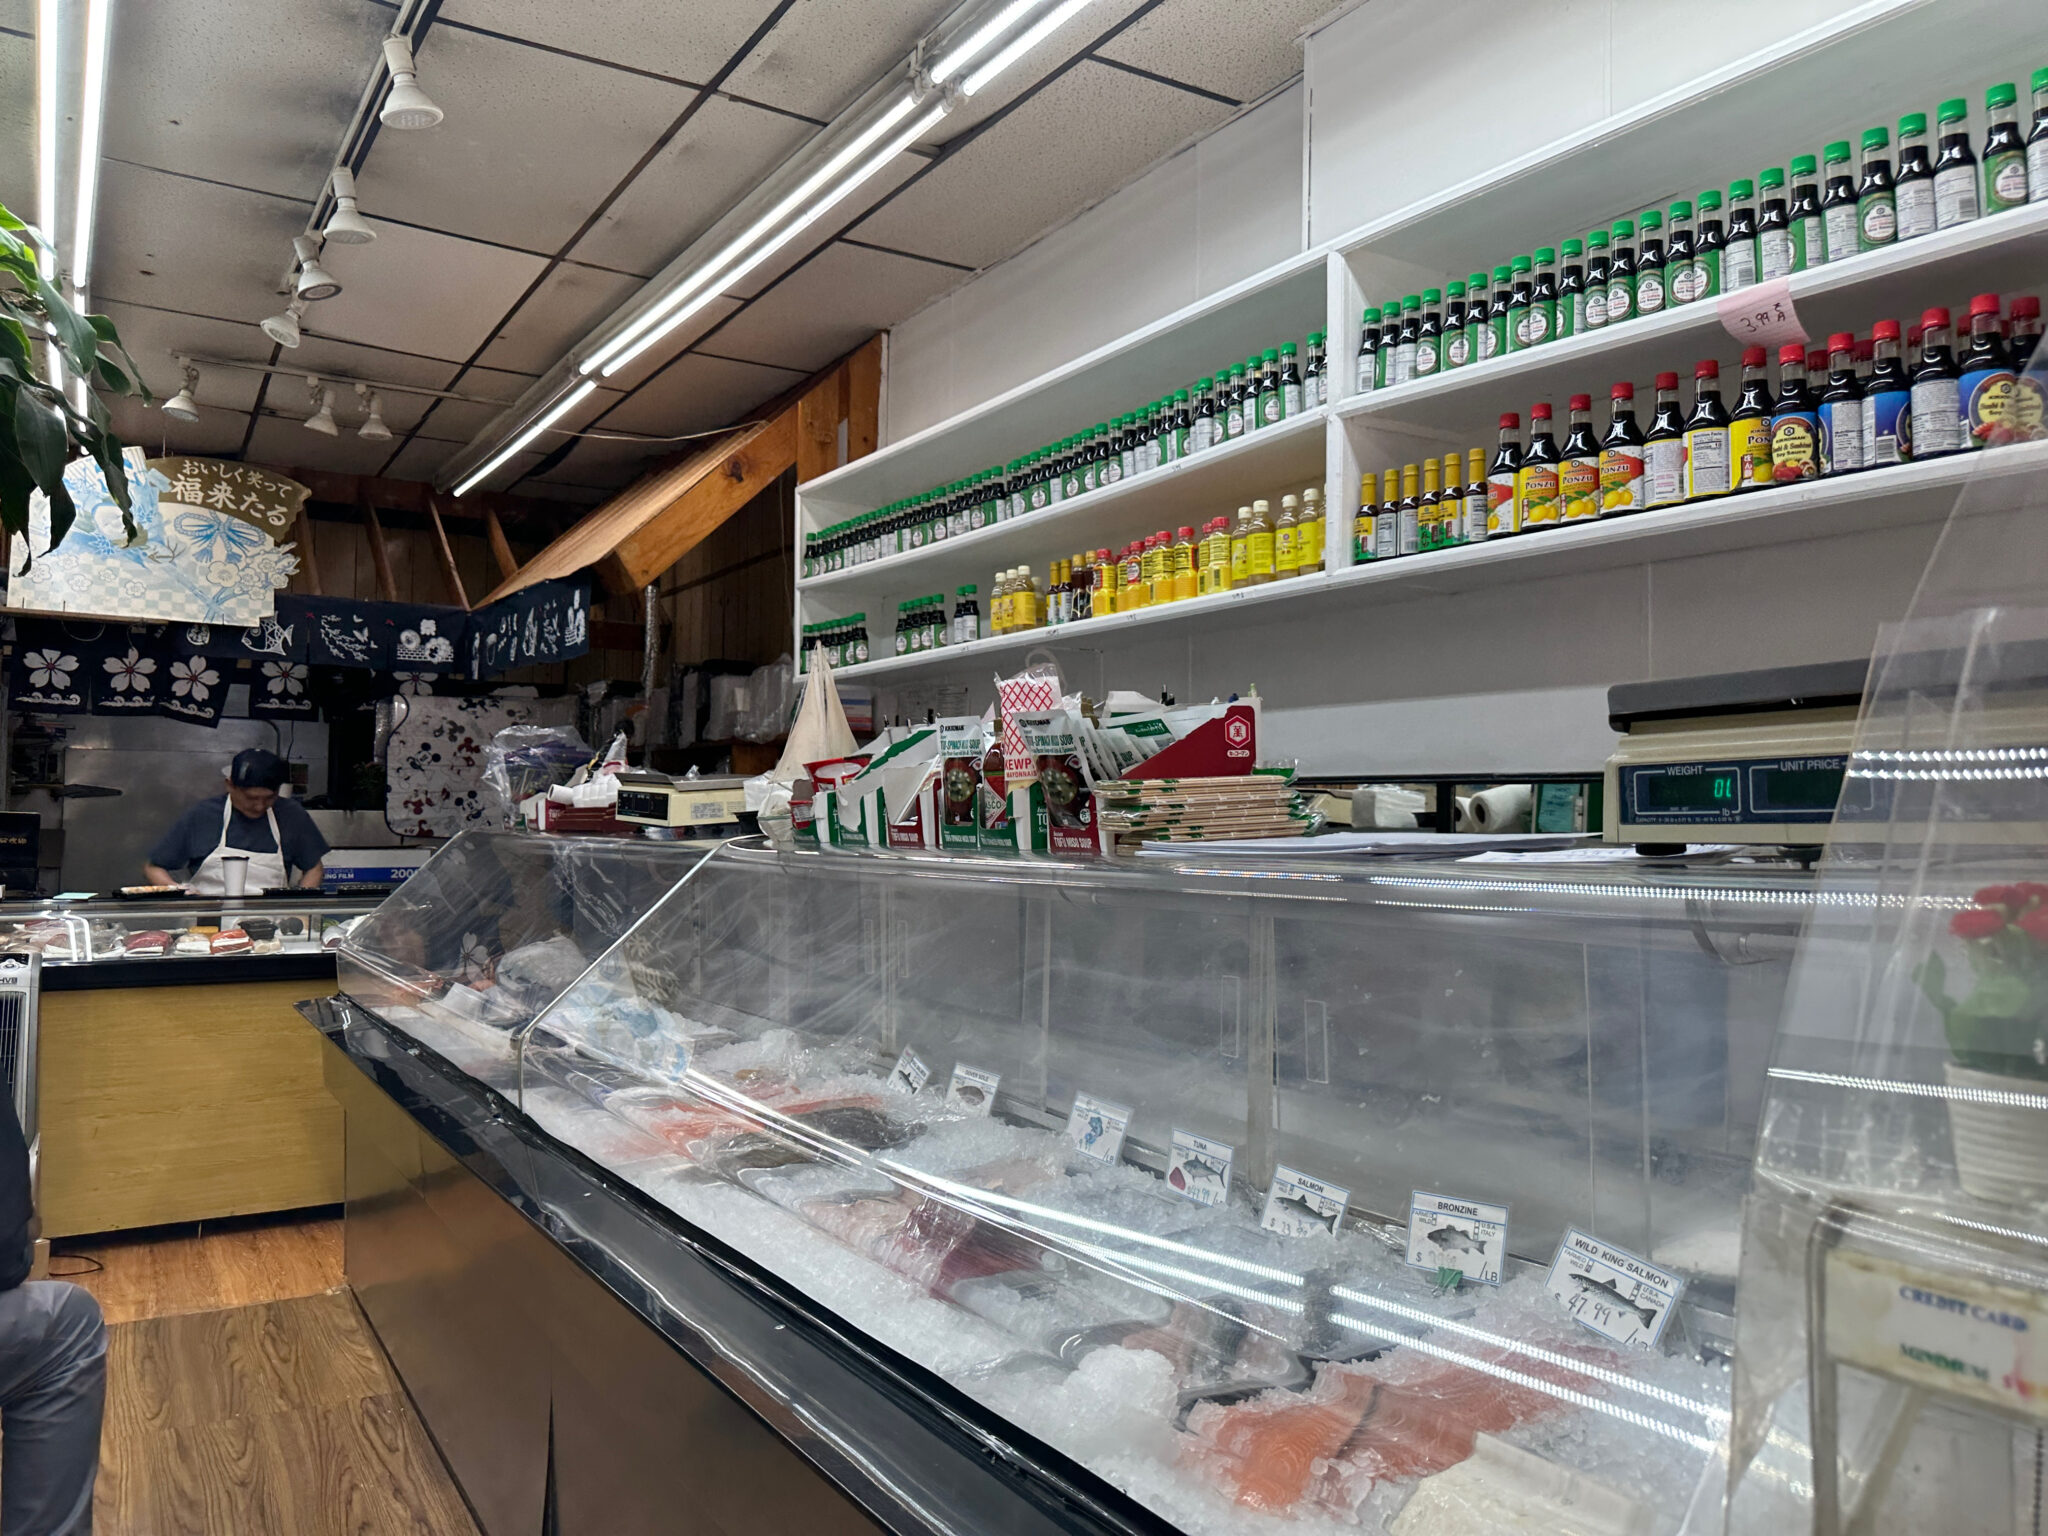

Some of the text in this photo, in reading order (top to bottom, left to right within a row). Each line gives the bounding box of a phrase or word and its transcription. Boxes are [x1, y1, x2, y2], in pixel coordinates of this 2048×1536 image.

[1740, 311, 1770, 332] 3.99
[1525, 481, 1556, 489] PONZU
[1562, 475, 1593, 484] PONZU
[170, 473, 289, 526] 福来たる
[1667, 766, 1703, 776] WEIGHT
[1780, 759, 1840, 771] UNIT PRICE
[1722, 808, 1730, 816] lb
[1054, 837, 1066, 847] TOFU
[1076, 838, 1092, 848] SOUP
[1193, 1140, 1207, 1151] TUNA
[1297, 1178, 1325, 1193] SALMON
[1437, 1202, 1479, 1216] BRONZINE
[1480, 1229, 1496, 1237] ITALY
[1575, 1238, 1669, 1289] WILD KING SALMON
[1639, 1293, 1665, 1309] CANADA
[1899, 1286, 2028, 1332] CREDIT CARD
